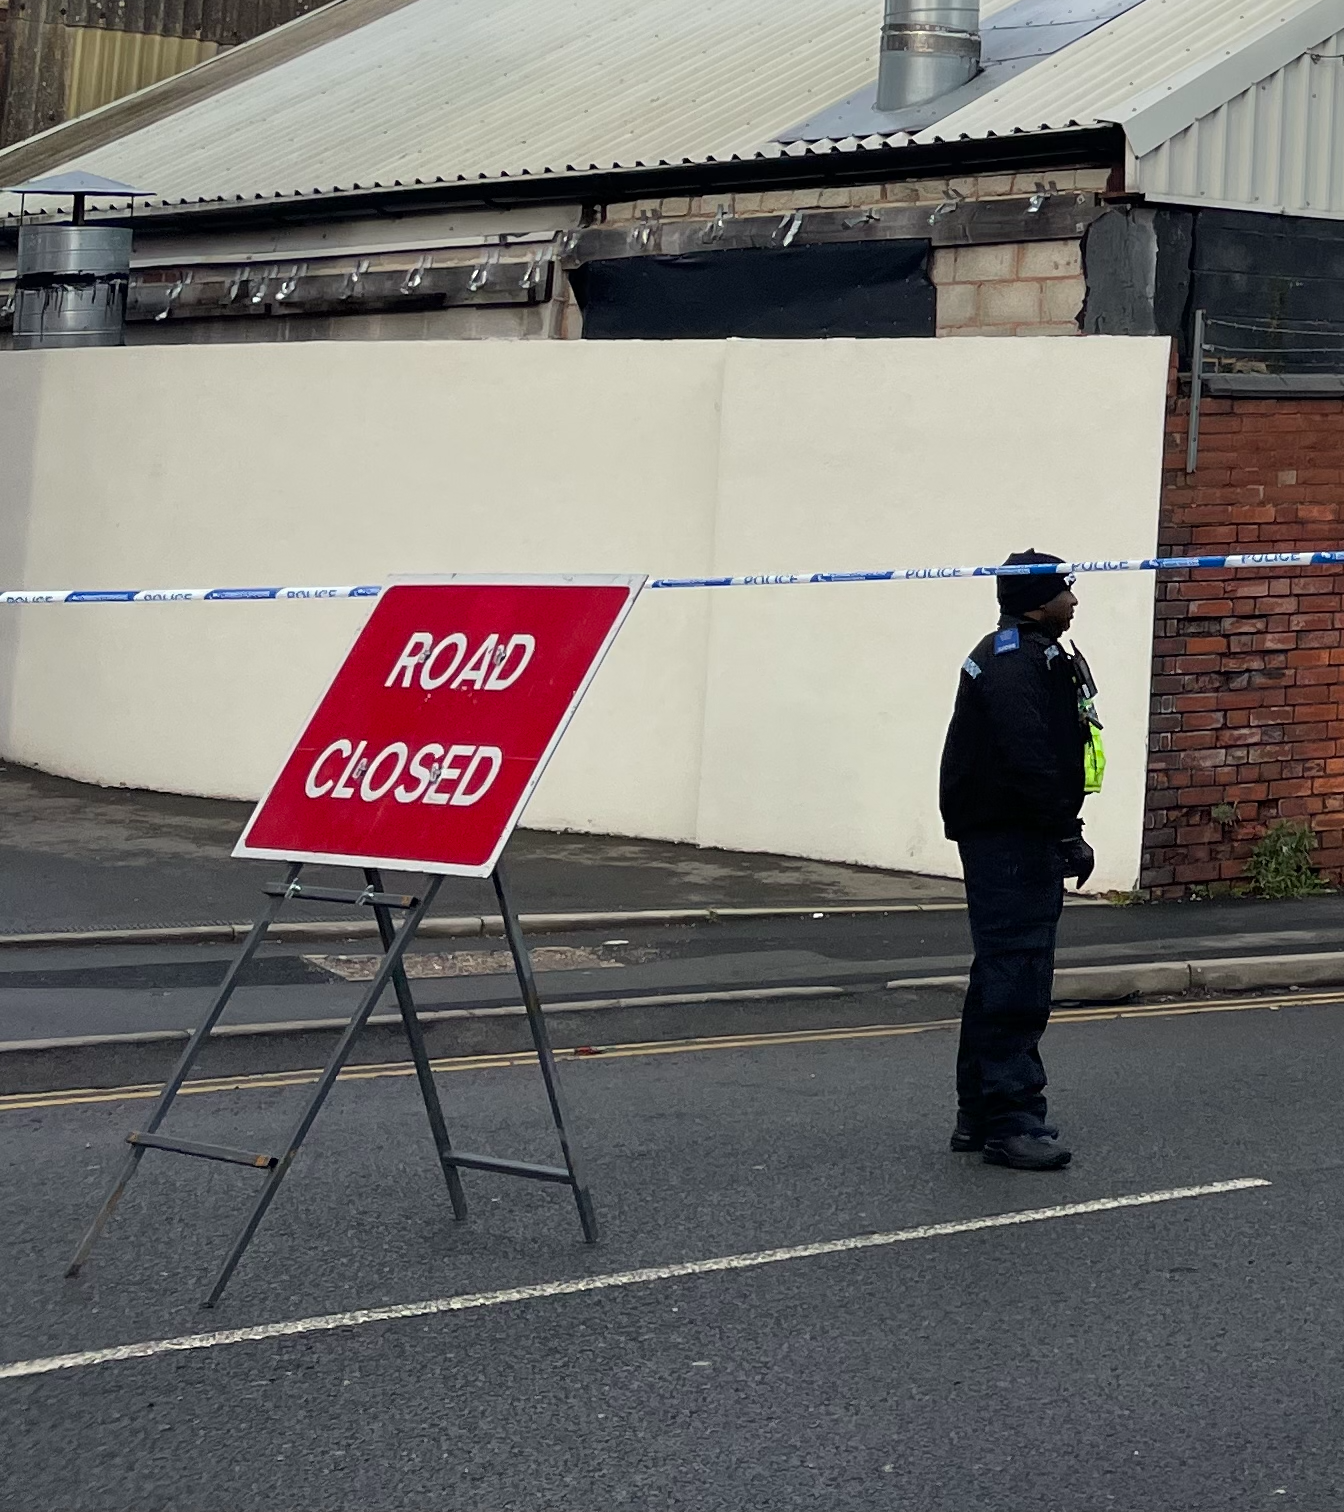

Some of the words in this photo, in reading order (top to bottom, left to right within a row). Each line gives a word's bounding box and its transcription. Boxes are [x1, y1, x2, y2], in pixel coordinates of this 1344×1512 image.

[1242, 553, 1301, 564] POLICE
[1072, 561, 1130, 571] POLICE
[906, 568, 961, 579] POLICE
[384, 632, 535, 691] ROAD
[305, 739, 502, 807] CLOSED
